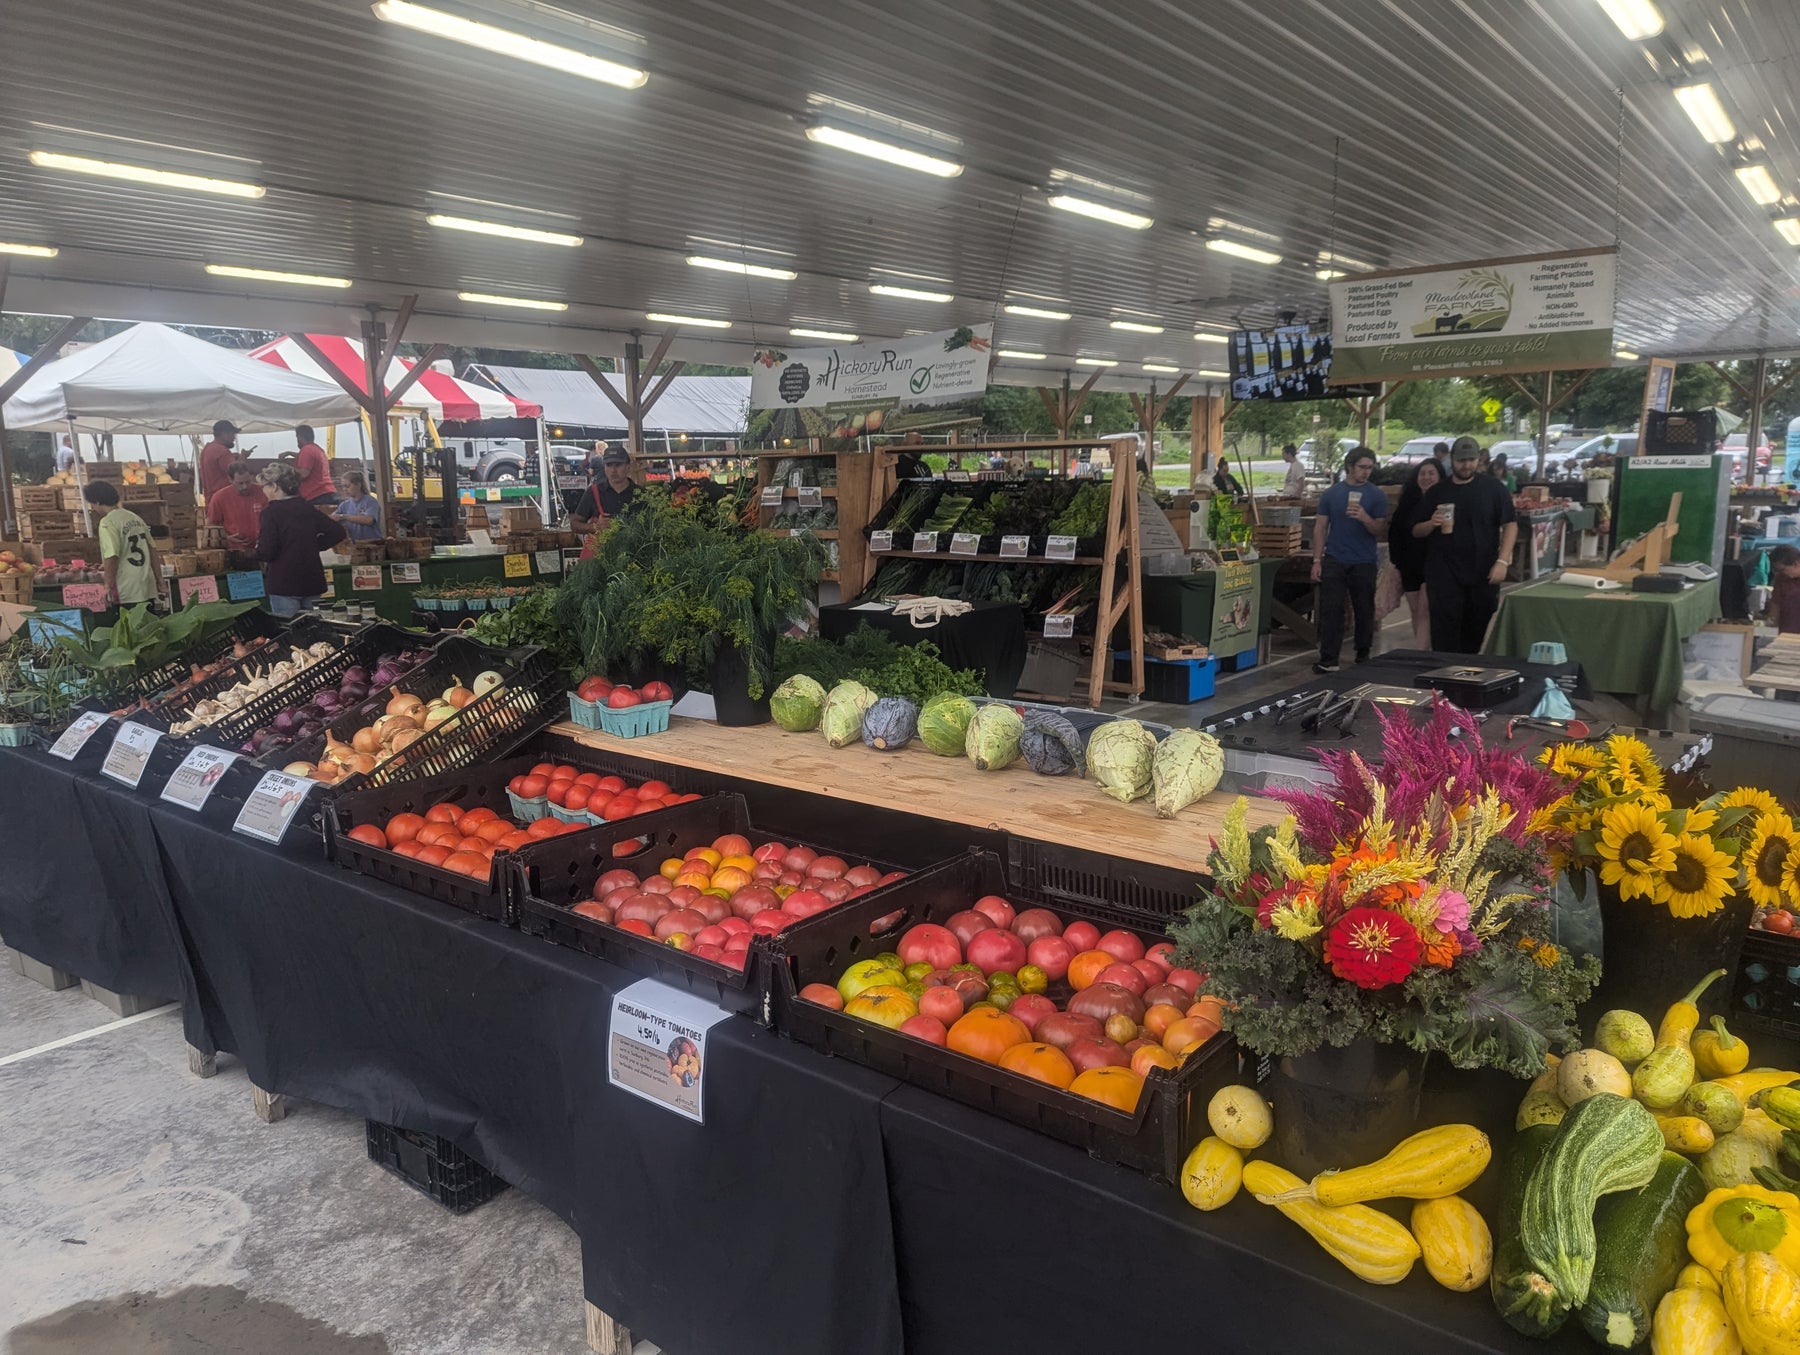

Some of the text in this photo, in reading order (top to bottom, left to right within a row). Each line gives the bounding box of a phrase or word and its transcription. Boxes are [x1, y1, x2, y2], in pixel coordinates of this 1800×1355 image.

[1541, 261, 1588, 272] Regenerative
[1530, 270, 1594, 281] Farming Practices
[1365, 282, 1397, 292] Grass-Fed
[1533, 280, 1594, 292] Humanely Raised
[1348, 291, 1399, 301] Pastured Poultry
[1425, 289, 1496, 303] Meadowland
[1546, 291, 1575, 299] Animals
[1348, 301, 1375, 310] Pastured
[1424, 300, 1496, 313] FARMS
[1545, 302, 1579, 310] NON-GMO
[1347, 309, 1393, 319] Pastured Eggs
[1538, 311, 1585, 320] Antibiotic-Free
[1346, 320, 1399, 332] Produced by
[1538, 320, 1560, 329] Added
[1561, 319, 1594, 327] Hormones
[1345, 331, 1401, 343] Local Farmers
[1378, 333, 1551, 362] From our farms to your table!
[881, 350, 912, 373] Run
[935, 359, 977, 371] Lovingly-grown
[934, 370, 971, 381] Regenerative
[844, 383, 887, 394] Homestead
[933, 380, 973, 390] Nutrient-dense
[618, 1002, 702, 1042] HEIRLOOM-TYPE TOMATOES
